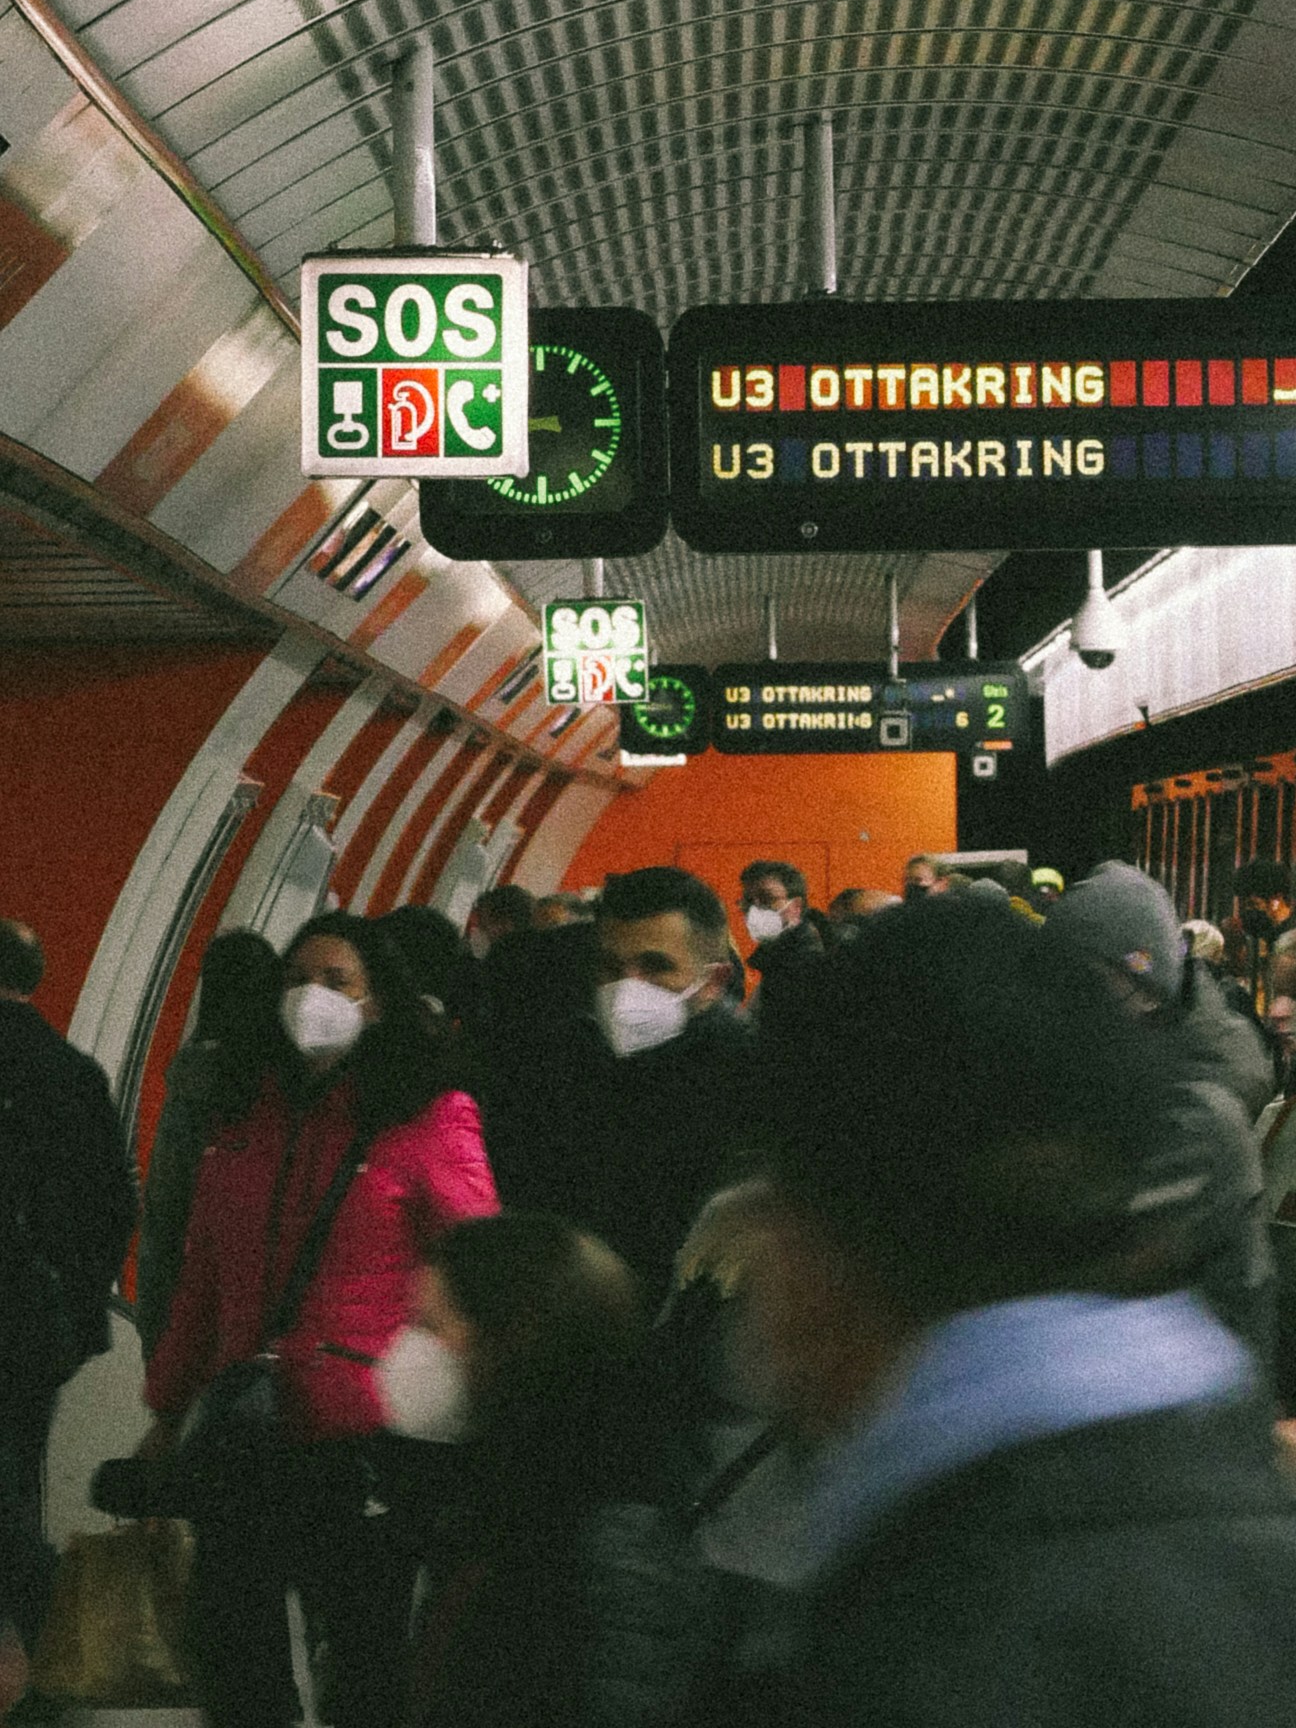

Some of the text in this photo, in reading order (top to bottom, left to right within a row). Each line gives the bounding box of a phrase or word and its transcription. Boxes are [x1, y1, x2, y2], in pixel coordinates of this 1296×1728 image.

[326, 283, 497, 359] SOS
[712, 365, 1104, 408] U3 OTTAKRING
[712, 441, 774, 480] U3
[811, 438, 1105, 479] OTTAKRING
[551, 605, 640, 651] SOS
[725, 685, 873, 703] U3 OTTAKRING
[726, 712, 873, 730] U3 OTTAKRING
[955, 711, 970, 728] 6
[987, 703, 1006, 729] 2
